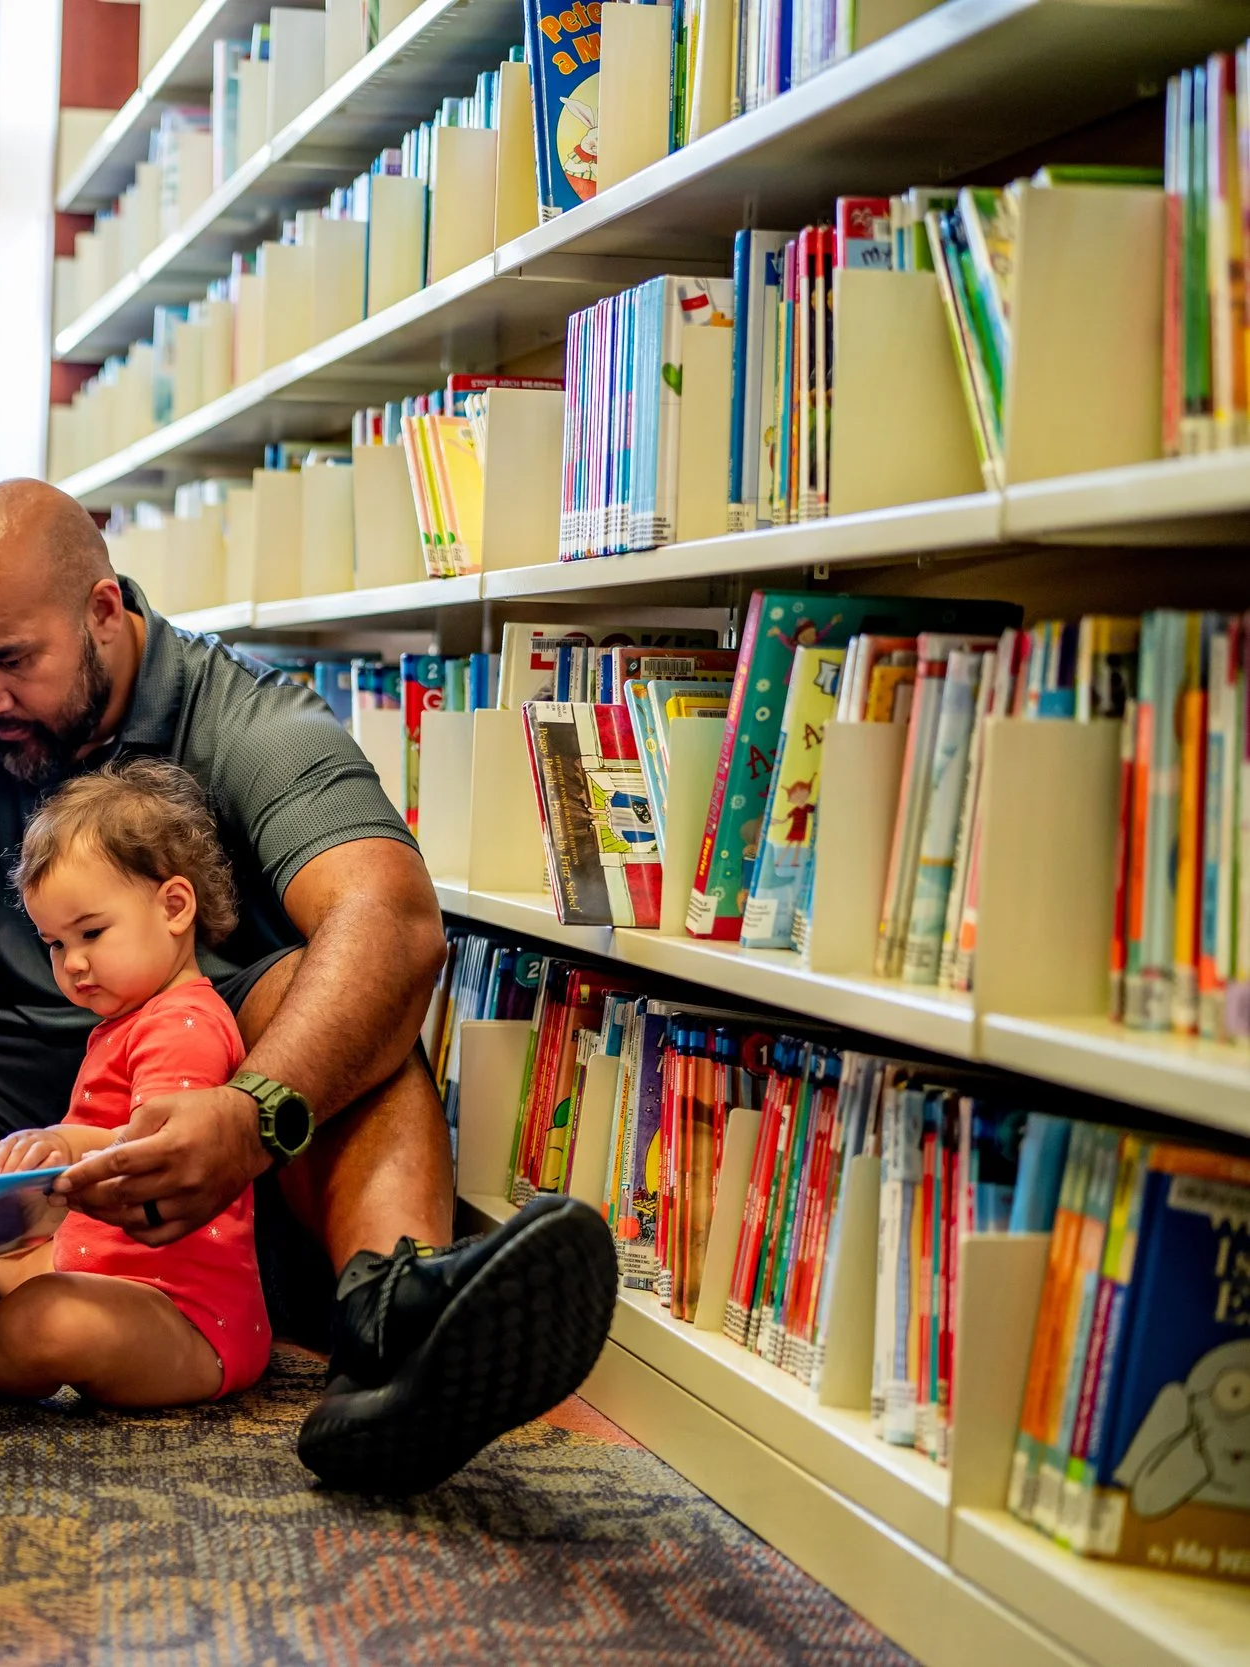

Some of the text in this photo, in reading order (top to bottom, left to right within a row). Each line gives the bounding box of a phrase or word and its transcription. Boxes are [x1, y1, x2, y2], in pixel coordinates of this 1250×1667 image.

[552, 51, 578, 75] a
[427, 663, 438, 680] 2
[538, 727, 580, 911] Peggy Parish Pictures by Fritz Siebel
[569, 836, 580, 866] EDITION
[699, 837, 712, 876] Stories
[527, 961, 540, 979] 2
[759, 1045, 768, 1066] 1
